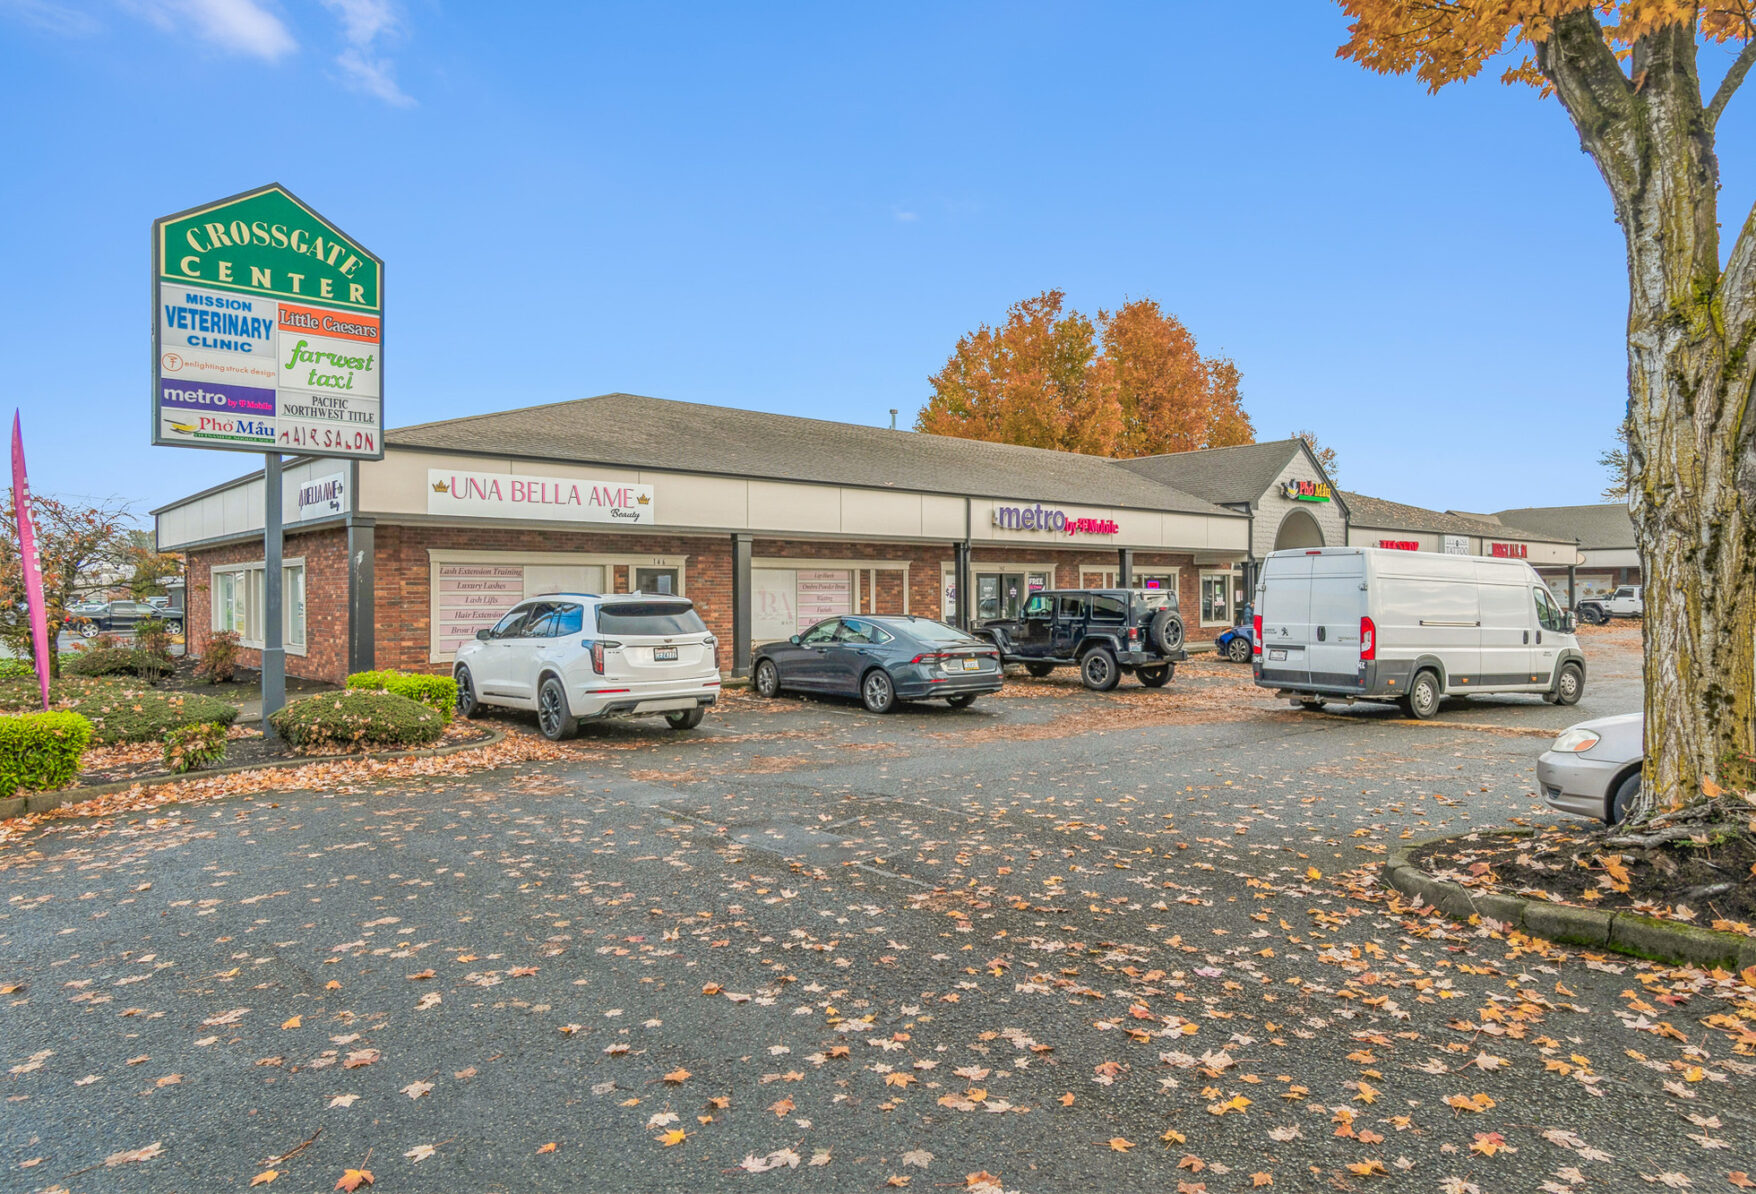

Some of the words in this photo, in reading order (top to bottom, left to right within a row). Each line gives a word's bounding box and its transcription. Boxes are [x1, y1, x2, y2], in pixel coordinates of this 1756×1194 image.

[186, 220, 364, 279] CROSSGATE
[180, 255, 367, 304] CENTER
[186, 293, 252, 312] MISSION
[165, 305, 273, 340] VETERINARY
[279, 309, 319, 330] Little
[322, 316, 377, 338] Caesars
[187, 335, 253, 353] CLINIC
[285, 340, 374, 372] farwest
[226, 365, 249, 374] struck
[250, 368, 276, 378] design
[307, 371, 353, 390] taxi
[163, 388, 227, 406] metro
[228, 398, 237, 408] by
[312, 395, 349, 410] PACIFIC
[283, 404, 345, 420] NORTHWEST
[347, 411, 375, 424] TITLE
[451, 475, 503, 502] UNA
[511, 480, 582, 506] BELLA
[588, 486, 636, 509] AME
[610, 508, 641, 523] Beauty
[999, 504, 1065, 531] metro
[440, 566, 457, 575] Lash
[458, 567, 492, 576] Extension
[493, 568, 522, 577] Training
[1029, 577, 1043, 585] FREE
[457, 582, 482, 591] Luxury
[483, 582, 506, 591] Lashes
[482, 597, 498, 606] Lifts
[455, 611, 471, 619] Hair
